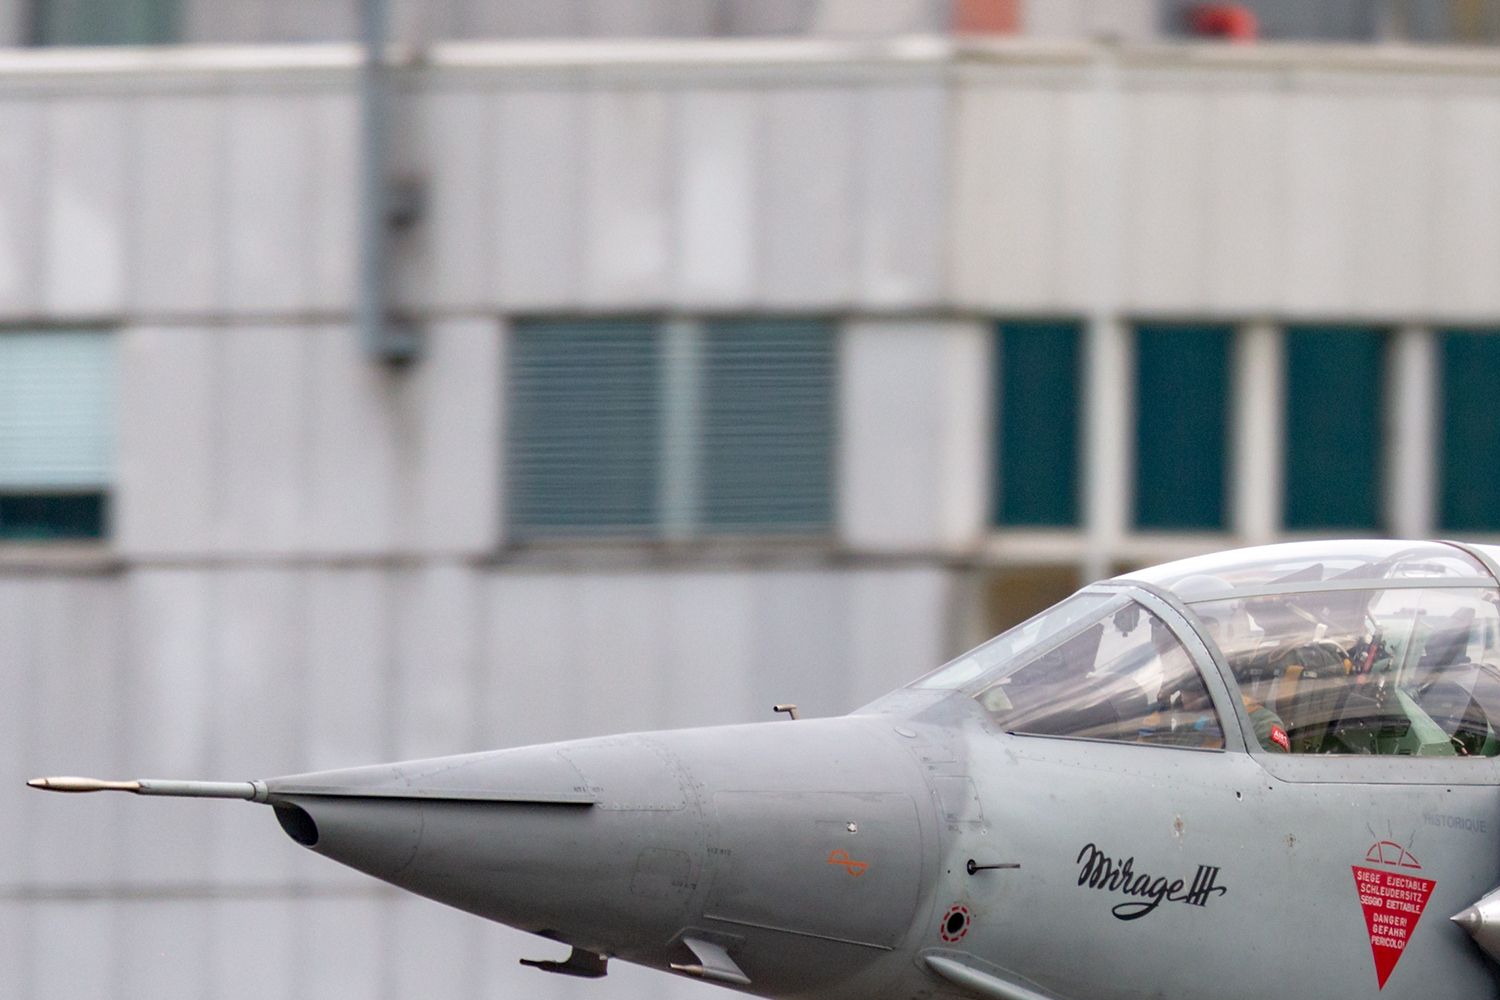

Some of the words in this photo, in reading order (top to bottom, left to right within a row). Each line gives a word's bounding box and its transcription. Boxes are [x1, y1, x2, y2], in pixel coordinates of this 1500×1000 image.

[1357, 870, 1381, 884] SIEGE
[1373, 912, 1408, 927] DANGER!
[1372, 923, 1407, 938] GEFAHR!
[1371, 934, 1405, 950] PERICOLO!
